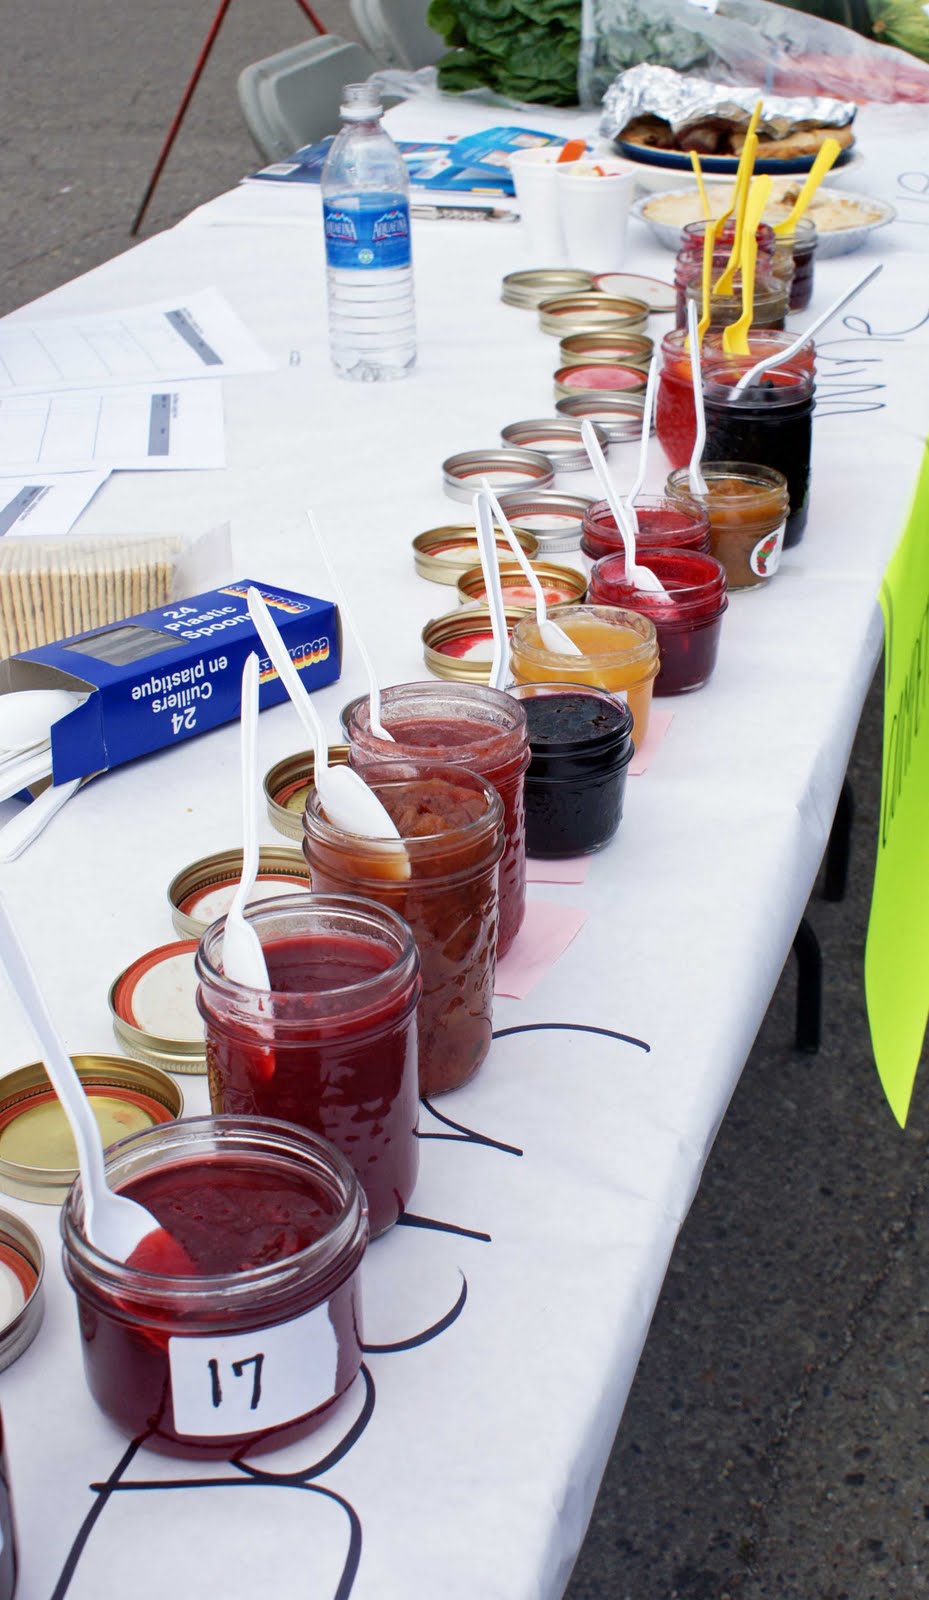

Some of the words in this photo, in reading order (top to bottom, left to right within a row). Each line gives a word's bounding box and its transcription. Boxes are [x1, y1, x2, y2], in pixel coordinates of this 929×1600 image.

[163, 606, 198, 619] 24
[164, 605, 237, 631] Plastic
[208, 656, 228, 673] en
[131, 659, 205, 700] plastique
[152, 682, 213, 713] Cuillers
[171, 706, 197, 735] 24
[207, 1352, 265, 1410] 17
